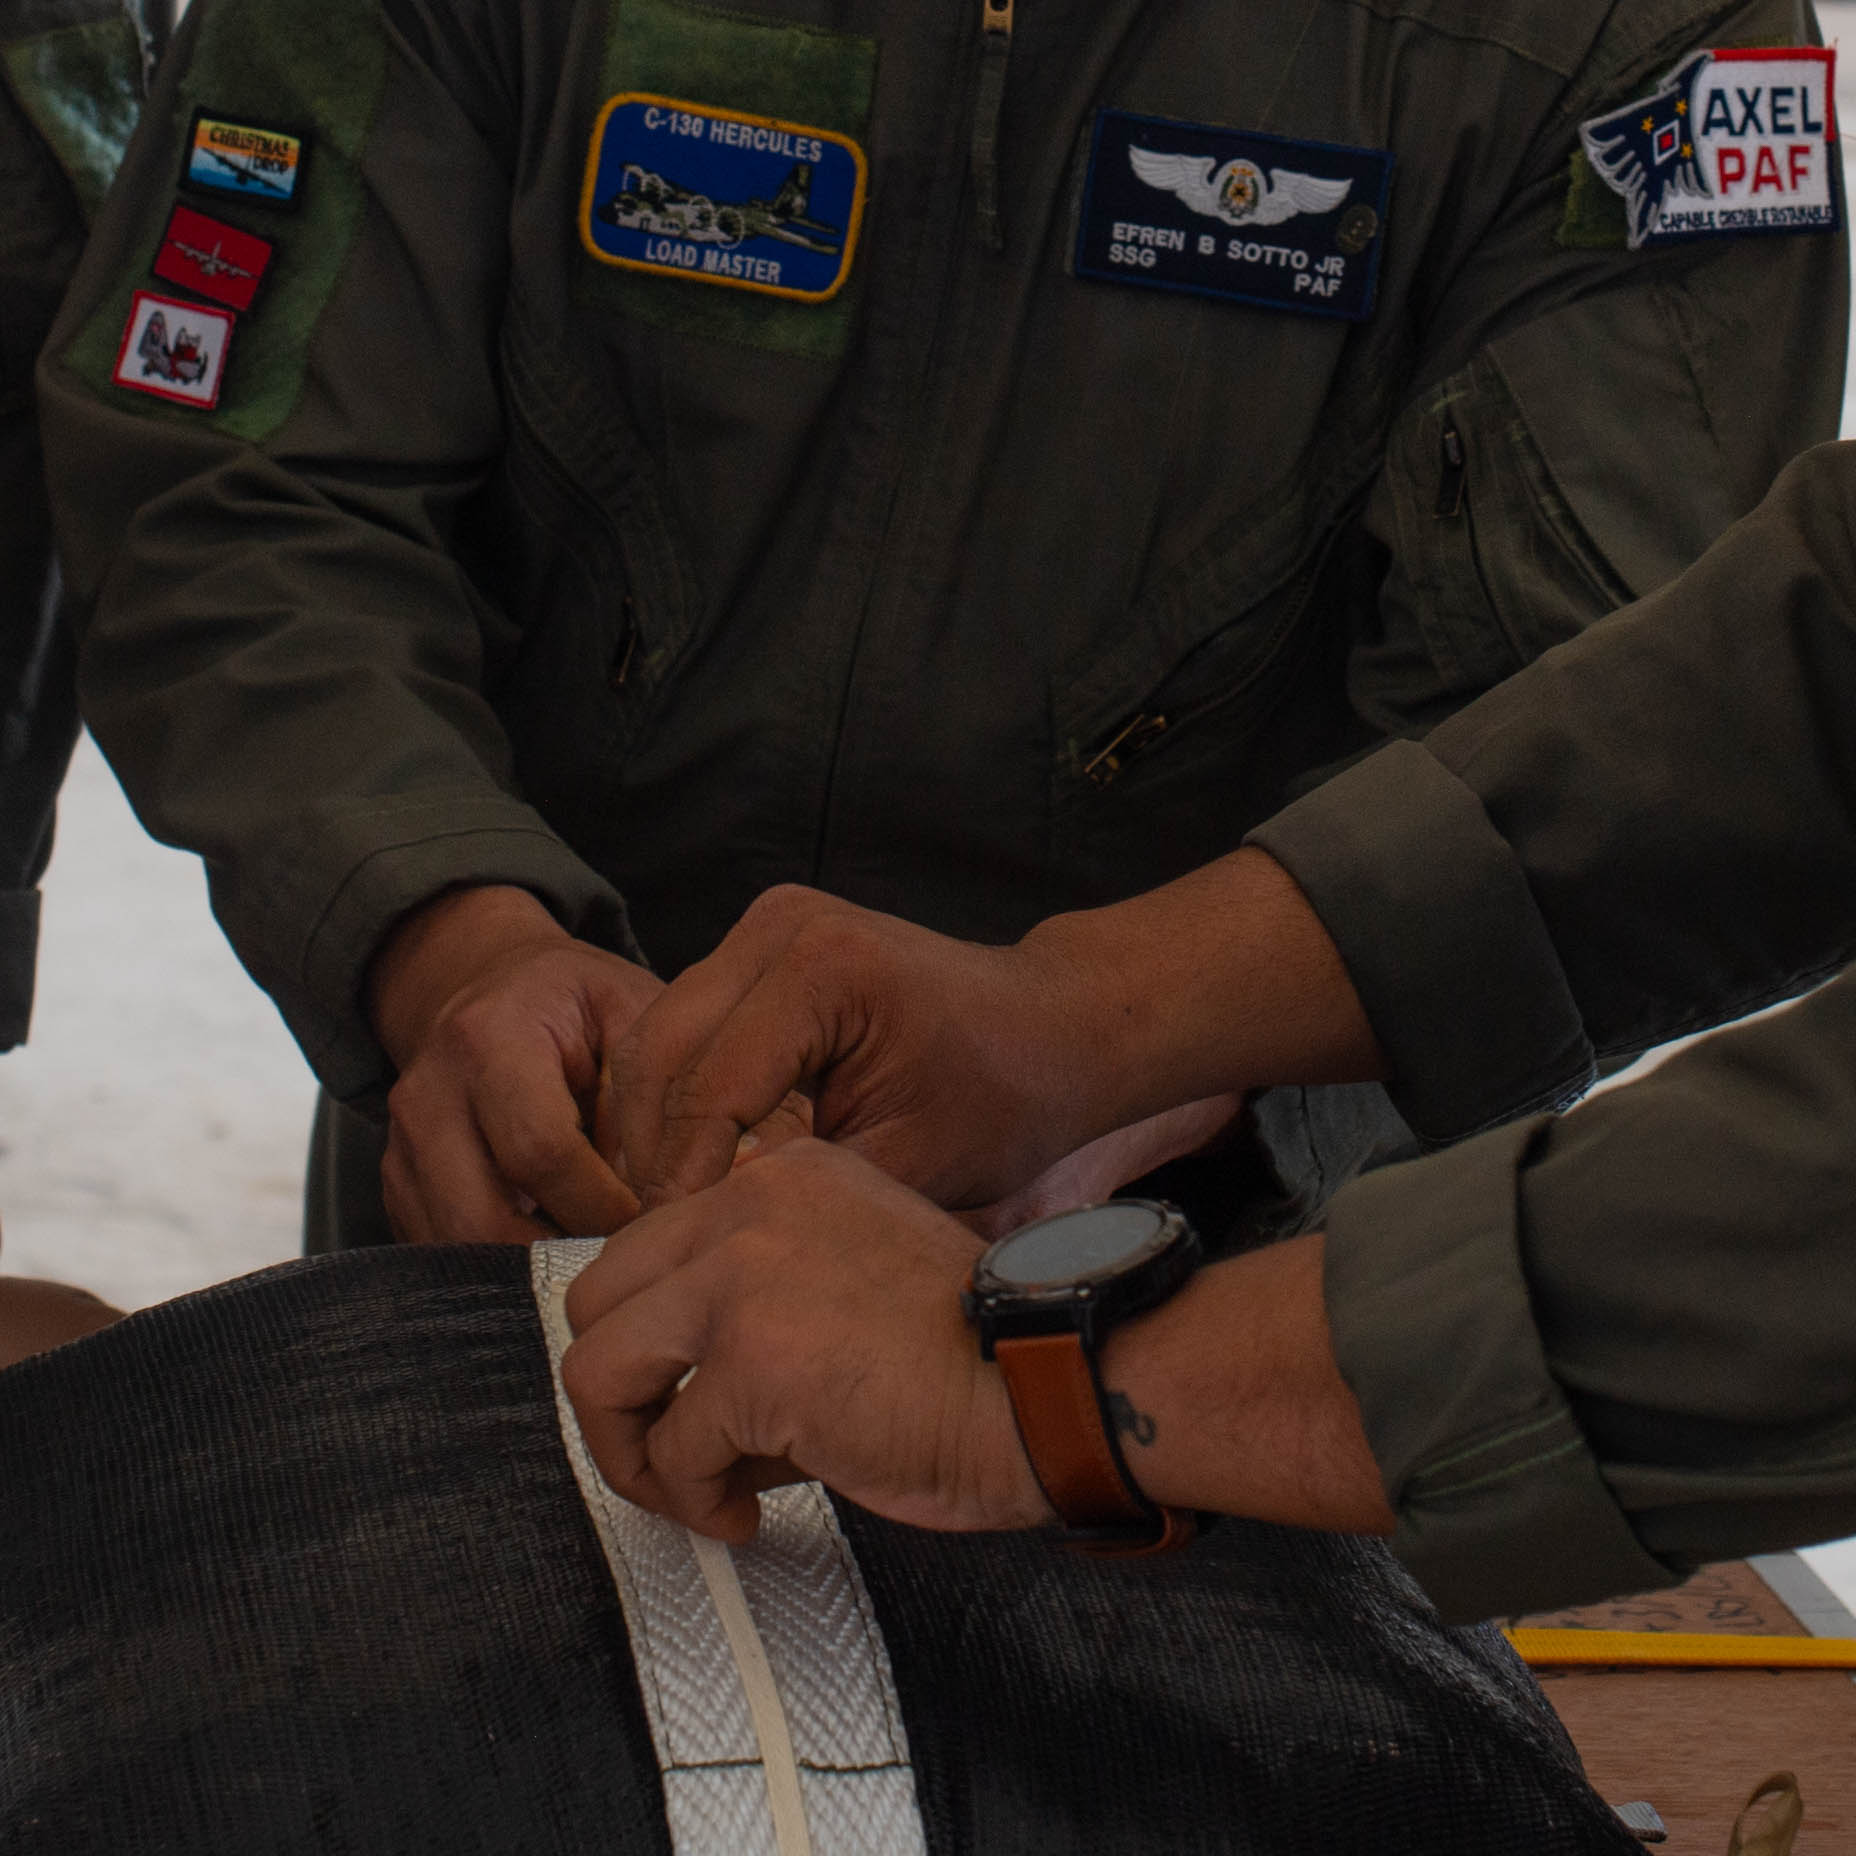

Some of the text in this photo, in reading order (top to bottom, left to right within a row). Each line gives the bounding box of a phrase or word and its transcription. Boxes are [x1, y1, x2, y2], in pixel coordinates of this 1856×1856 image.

[644, 106, 823, 163] C-130 HERCULES
[1702, 86, 1822, 136] AXEL
[1716, 145, 1811, 195] PAF
[644, 238, 782, 285] LOAD MASTER
[1108, 243, 1157, 269] SSG
[1111, 222, 1345, 277] EFREN B SOTTO JR
[1293, 272, 1344, 298] PAF
